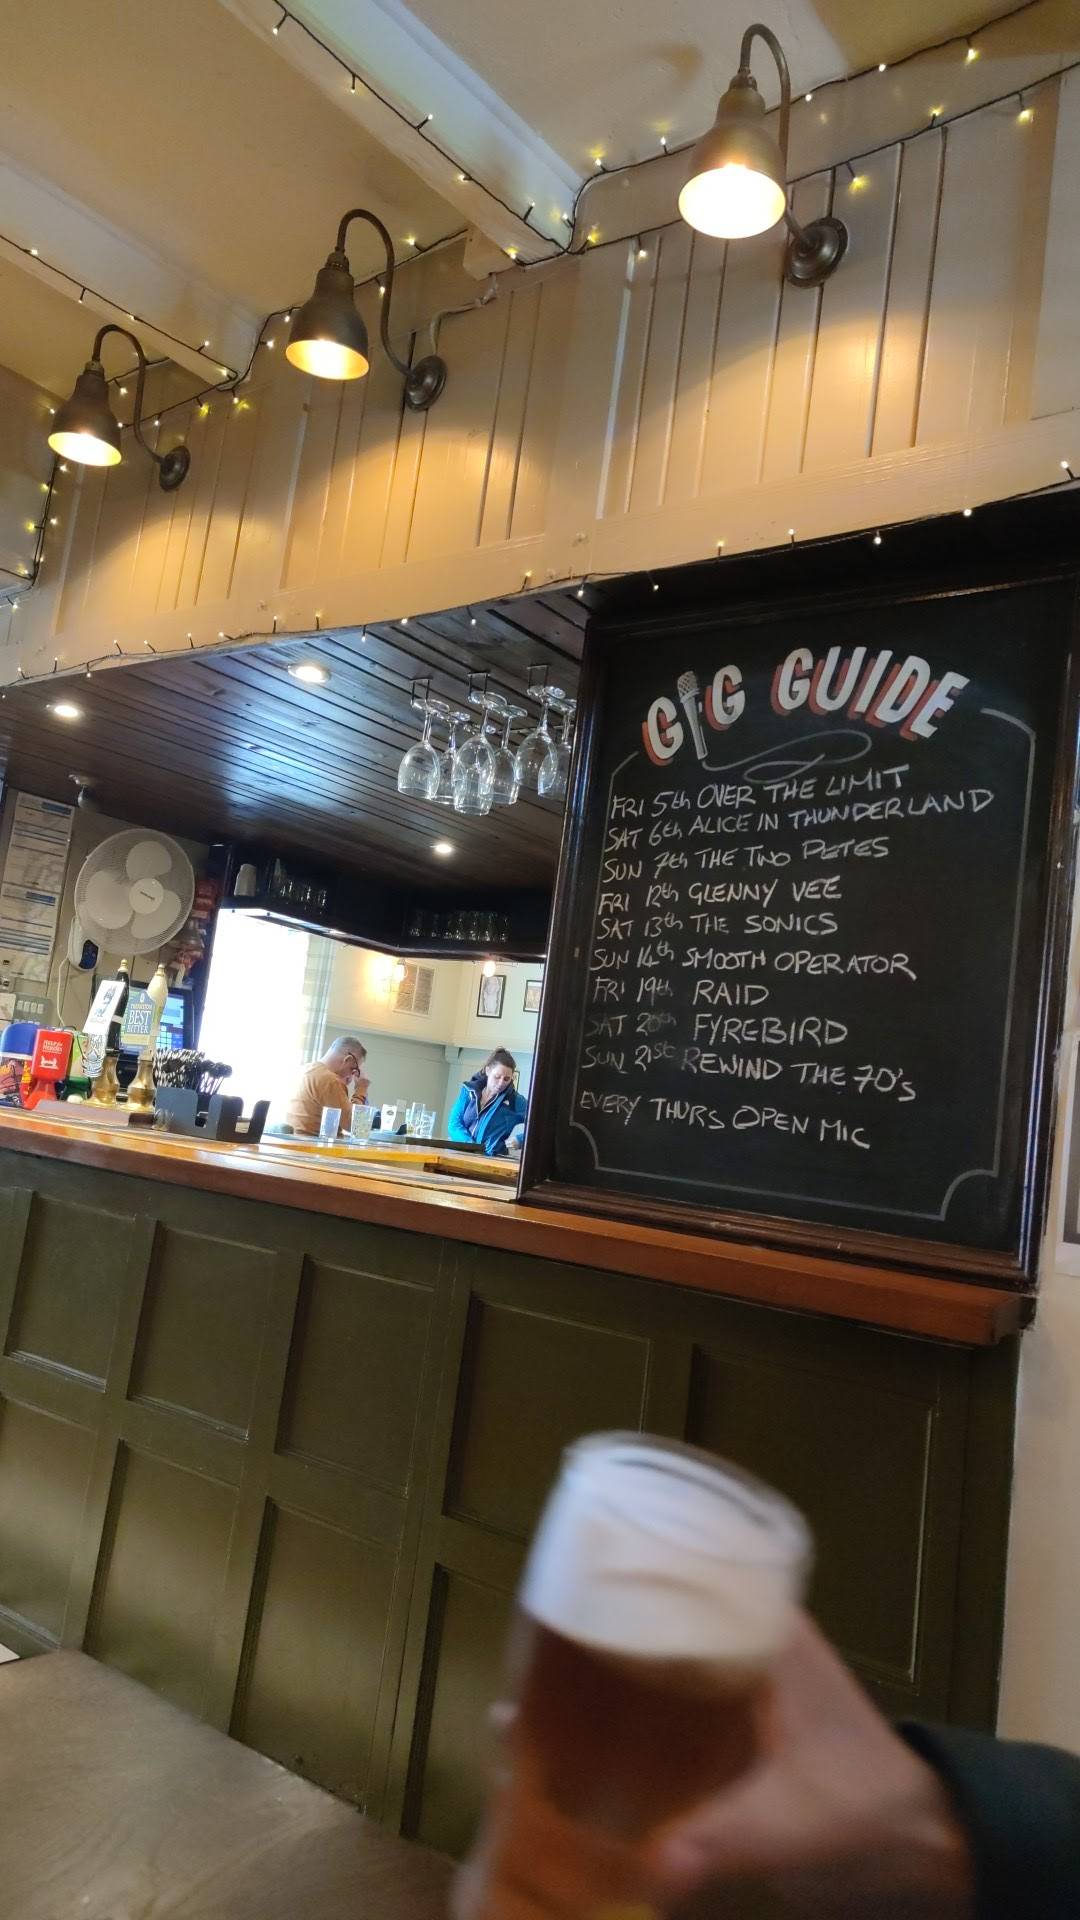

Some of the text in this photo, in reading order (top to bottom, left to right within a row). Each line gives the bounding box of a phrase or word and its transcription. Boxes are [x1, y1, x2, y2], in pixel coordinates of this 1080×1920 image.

[642, 646, 970, 766] GIG GUIDE
[611, 763, 910, 820] FRI 5th OVER THE LIMIT
[604, 788, 995, 853] SAT 6th ALICE IN THUNDERLAND
[602, 837, 890, 883] SUN 7th THE TWO PETES
[598, 875, 842, 915] FRI 12th GLENNY VEE
[597, 911, 838, 940] SAT 13th THE SONICS
[589, 940, 917, 981] SUN 14th SMOOTH OPERATOR
[592, 975, 770, 1006] FRI 19th RAID
[128, 1009, 152, 1025] BEST
[585, 1012, 849, 1047] SAT 20th FYREBIRD
[581, 1045, 629, 1074] SUN
[634, 1041, 677, 1072] 21st
[680, 1047, 783, 1081] REWIND
[789, 1062, 846, 1086] THE
[579, 1090, 871, 1150] EVERY THURS OPEN MIC
